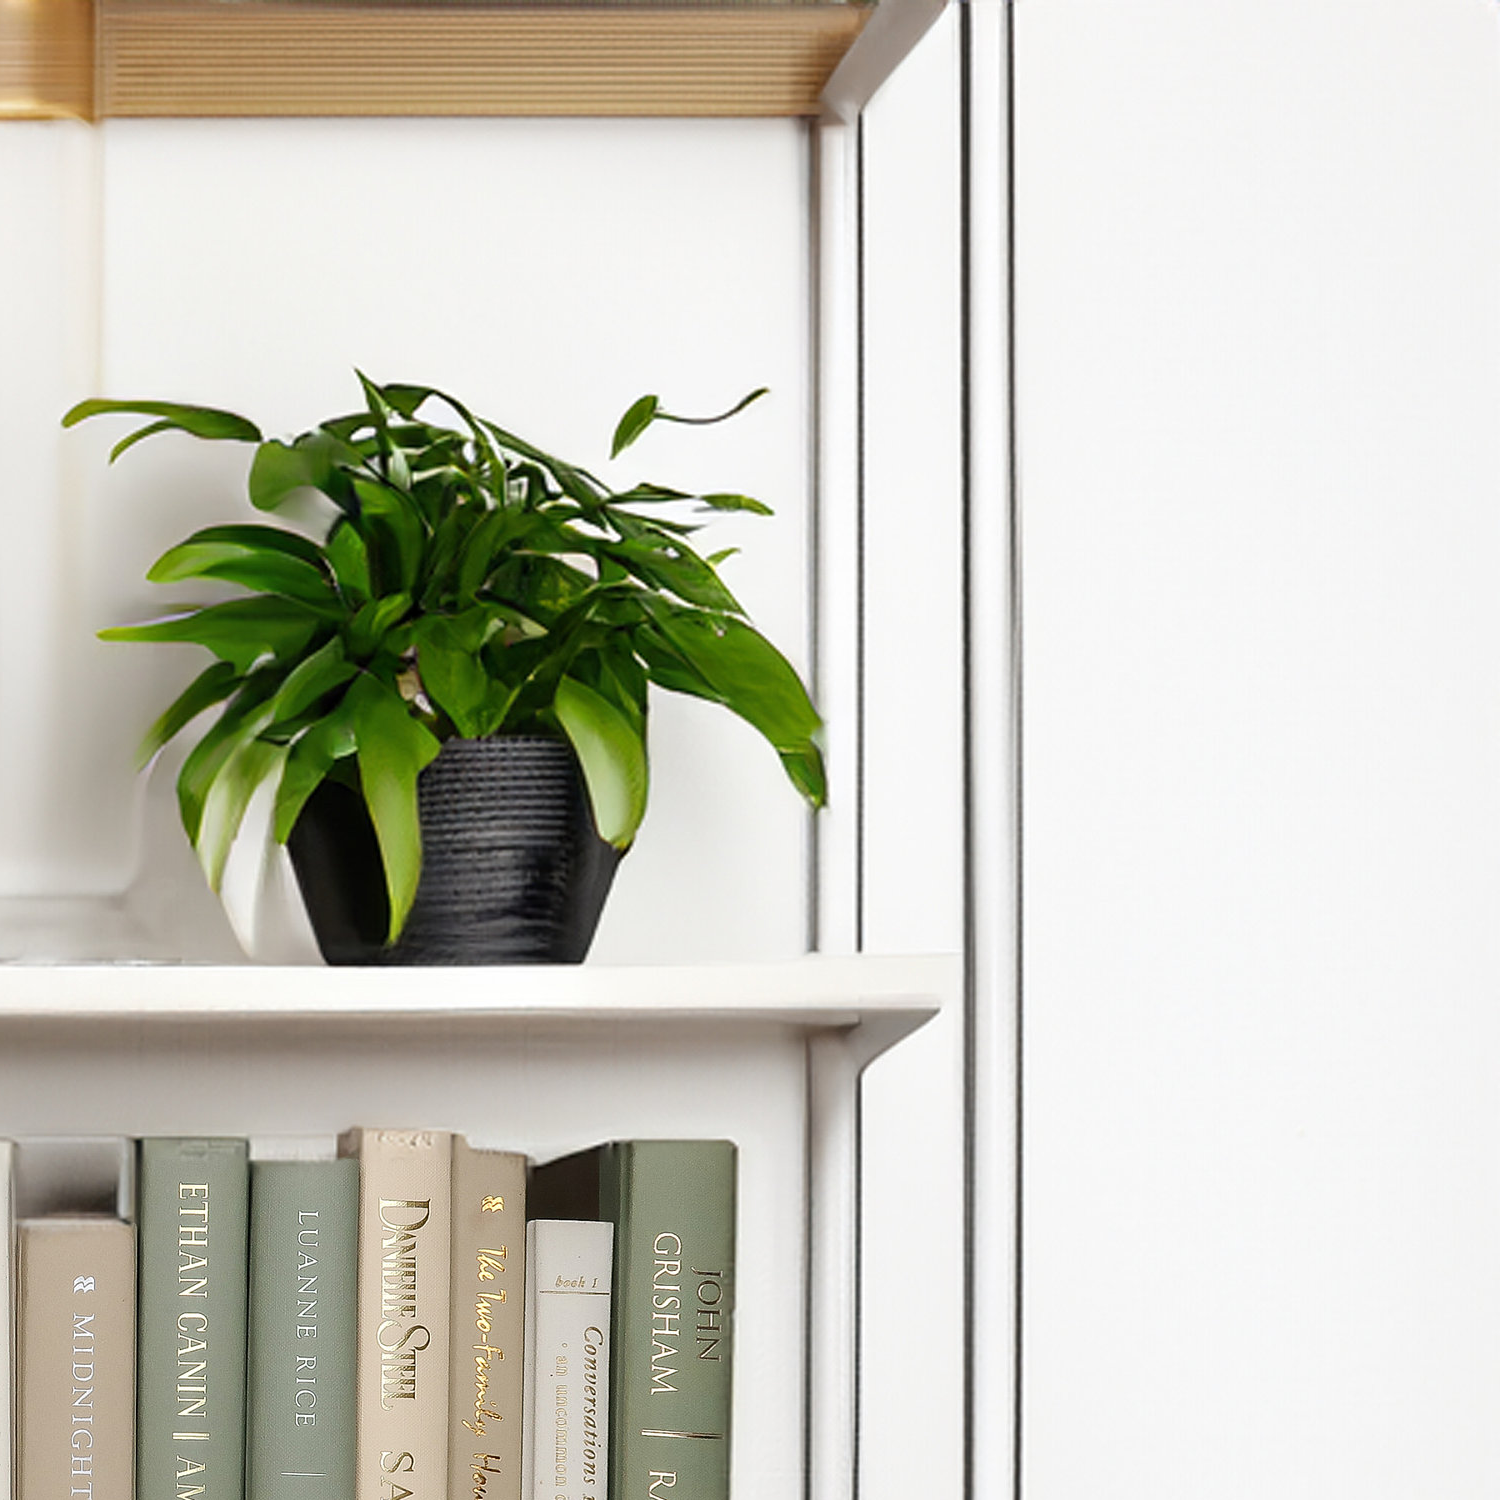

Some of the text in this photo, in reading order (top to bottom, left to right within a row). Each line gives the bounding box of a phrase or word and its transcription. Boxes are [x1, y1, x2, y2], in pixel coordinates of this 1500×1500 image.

[176, 1181, 209, 1418] ETHAN CANIN
[294, 1210, 320, 1428] LUANNE RICE
[377, 1197, 431, 1319] DANIELLE
[476, 1245, 508, 1282] The
[555, 1275, 586, 1290] book
[650, 1231, 683, 1396] GRISHAM
[691, 1267, 723, 1363] JOHN
[69, 1312, 96, 1500] MIDNIGHT
[461, 1289, 507, 1438] Two-Family
[555, 1355, 568, 1377] an
[578, 1326, 604, 1485] Conversations
[554, 1384, 569, 1487] uncommon
